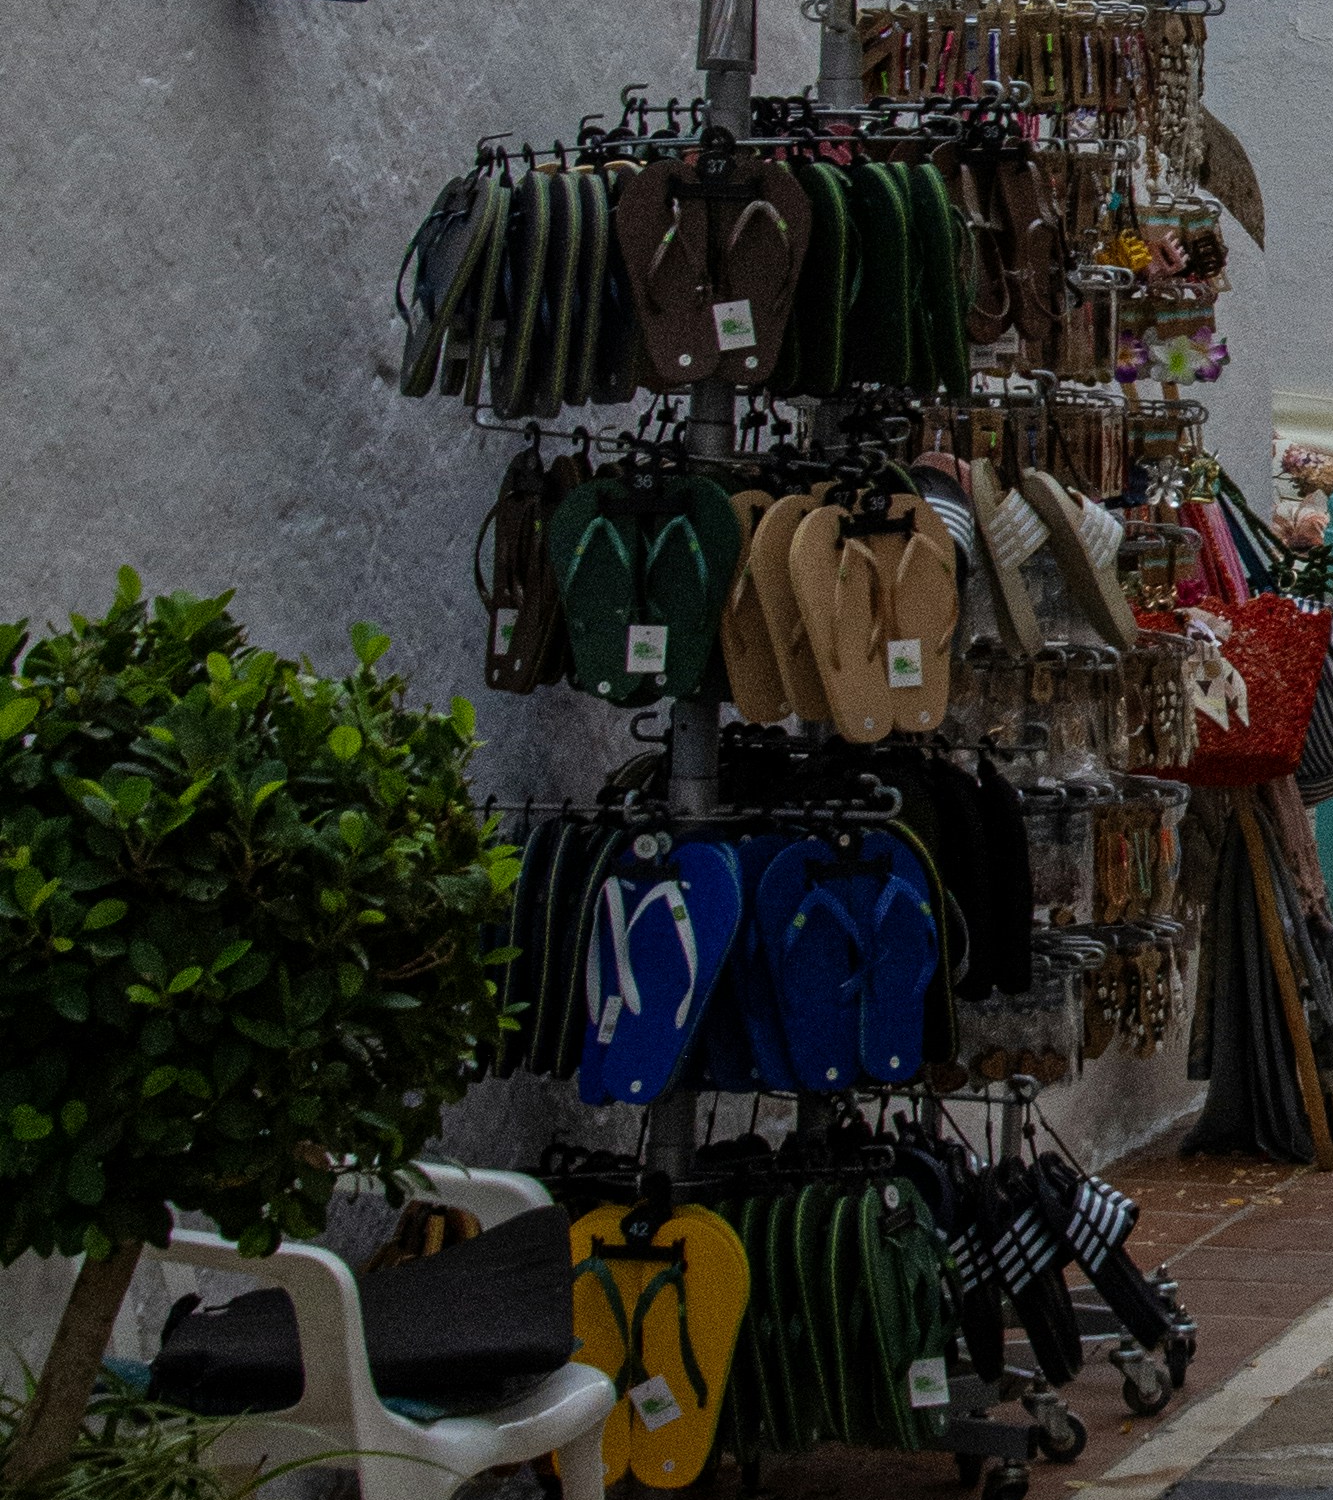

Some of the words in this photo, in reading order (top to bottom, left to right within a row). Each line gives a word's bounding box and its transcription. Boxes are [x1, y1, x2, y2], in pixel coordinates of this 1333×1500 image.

[706, 159, 727, 174] 37
[632, 474, 654, 490] 36
[628, 1221, 649, 1237] 42
